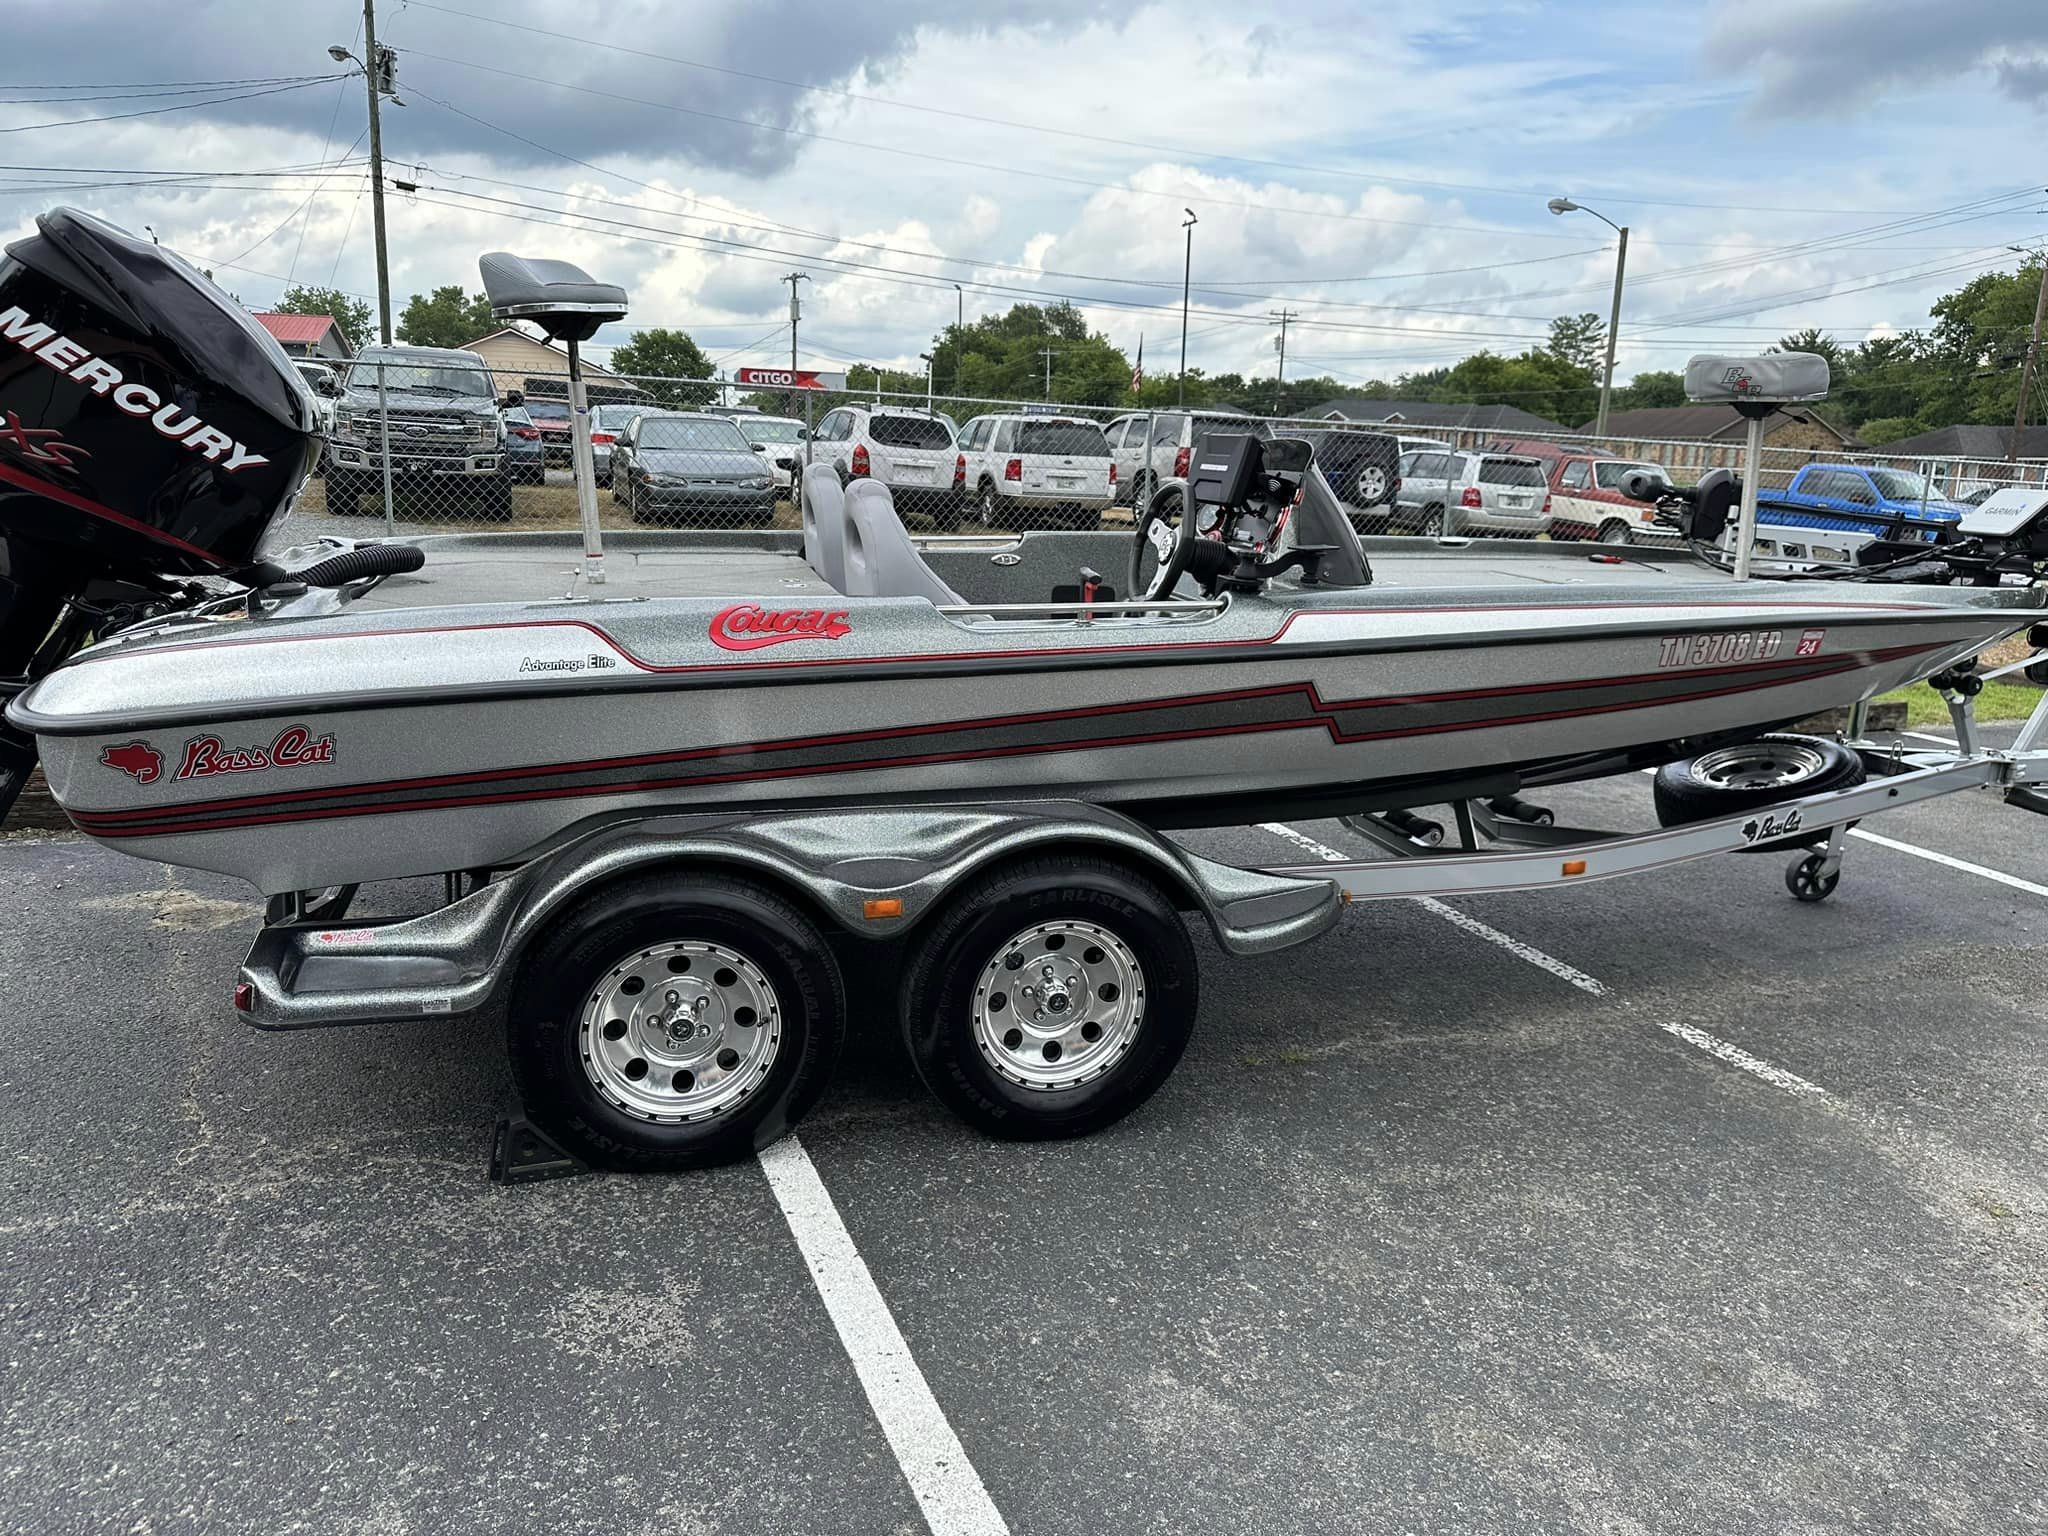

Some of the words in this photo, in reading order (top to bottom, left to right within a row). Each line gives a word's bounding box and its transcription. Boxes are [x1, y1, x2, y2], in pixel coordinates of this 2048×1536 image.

[0, 305, 270, 472] MERCURY
[748, 371, 793, 385] CITGO
[1984, 505, 2023, 517] GARMIN
[709, 601, 851, 651] Cougar
[1659, 636, 1692, 668] TN
[1692, 632, 1752, 665] 3708
[1751, 629, 1784, 661] ED
[1799, 640, 1816, 655] 24
[519, 657, 585, 672] Advantage
[587, 654, 616, 669] Elite
[172, 734, 270, 782] Bass
[270, 724, 336, 768] Cat
[1782, 809, 1802, 834] Cat
